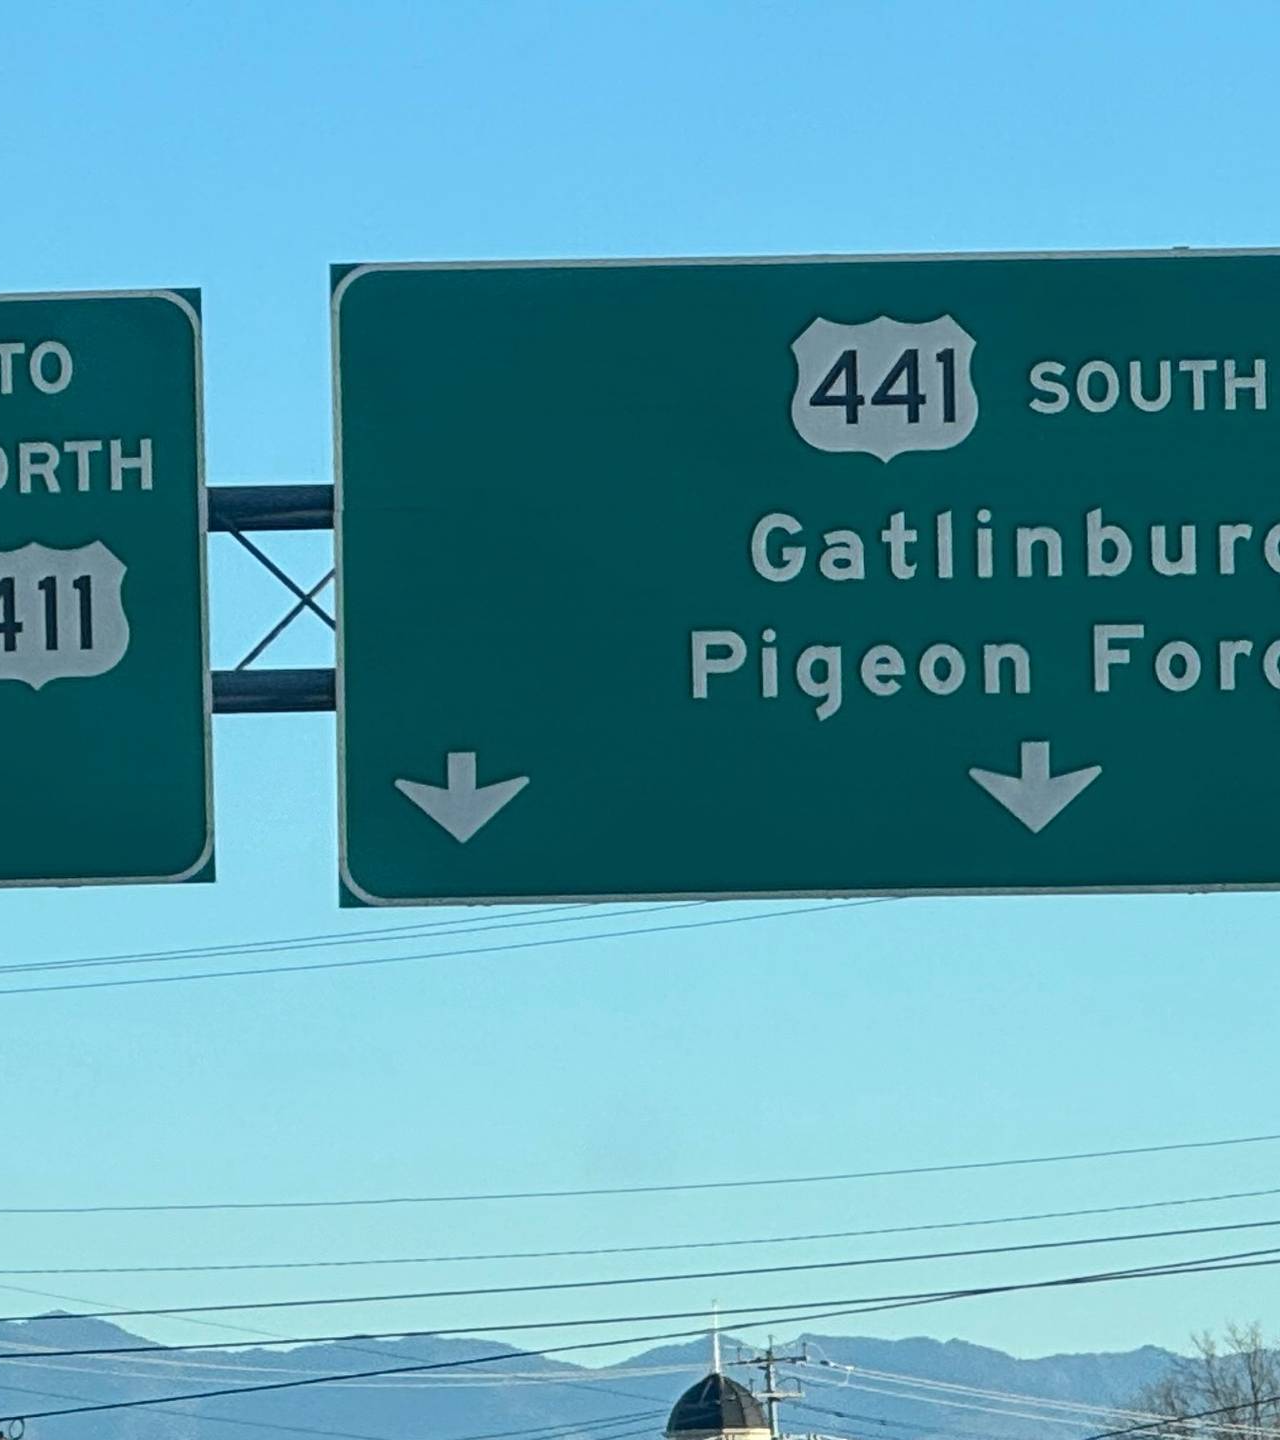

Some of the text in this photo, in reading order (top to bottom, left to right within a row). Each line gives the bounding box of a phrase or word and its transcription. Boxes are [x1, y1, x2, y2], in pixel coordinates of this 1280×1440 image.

[808, 348, 1270, 425] 441 SOUTH
[689, 627, 1034, 722] Pigeon
